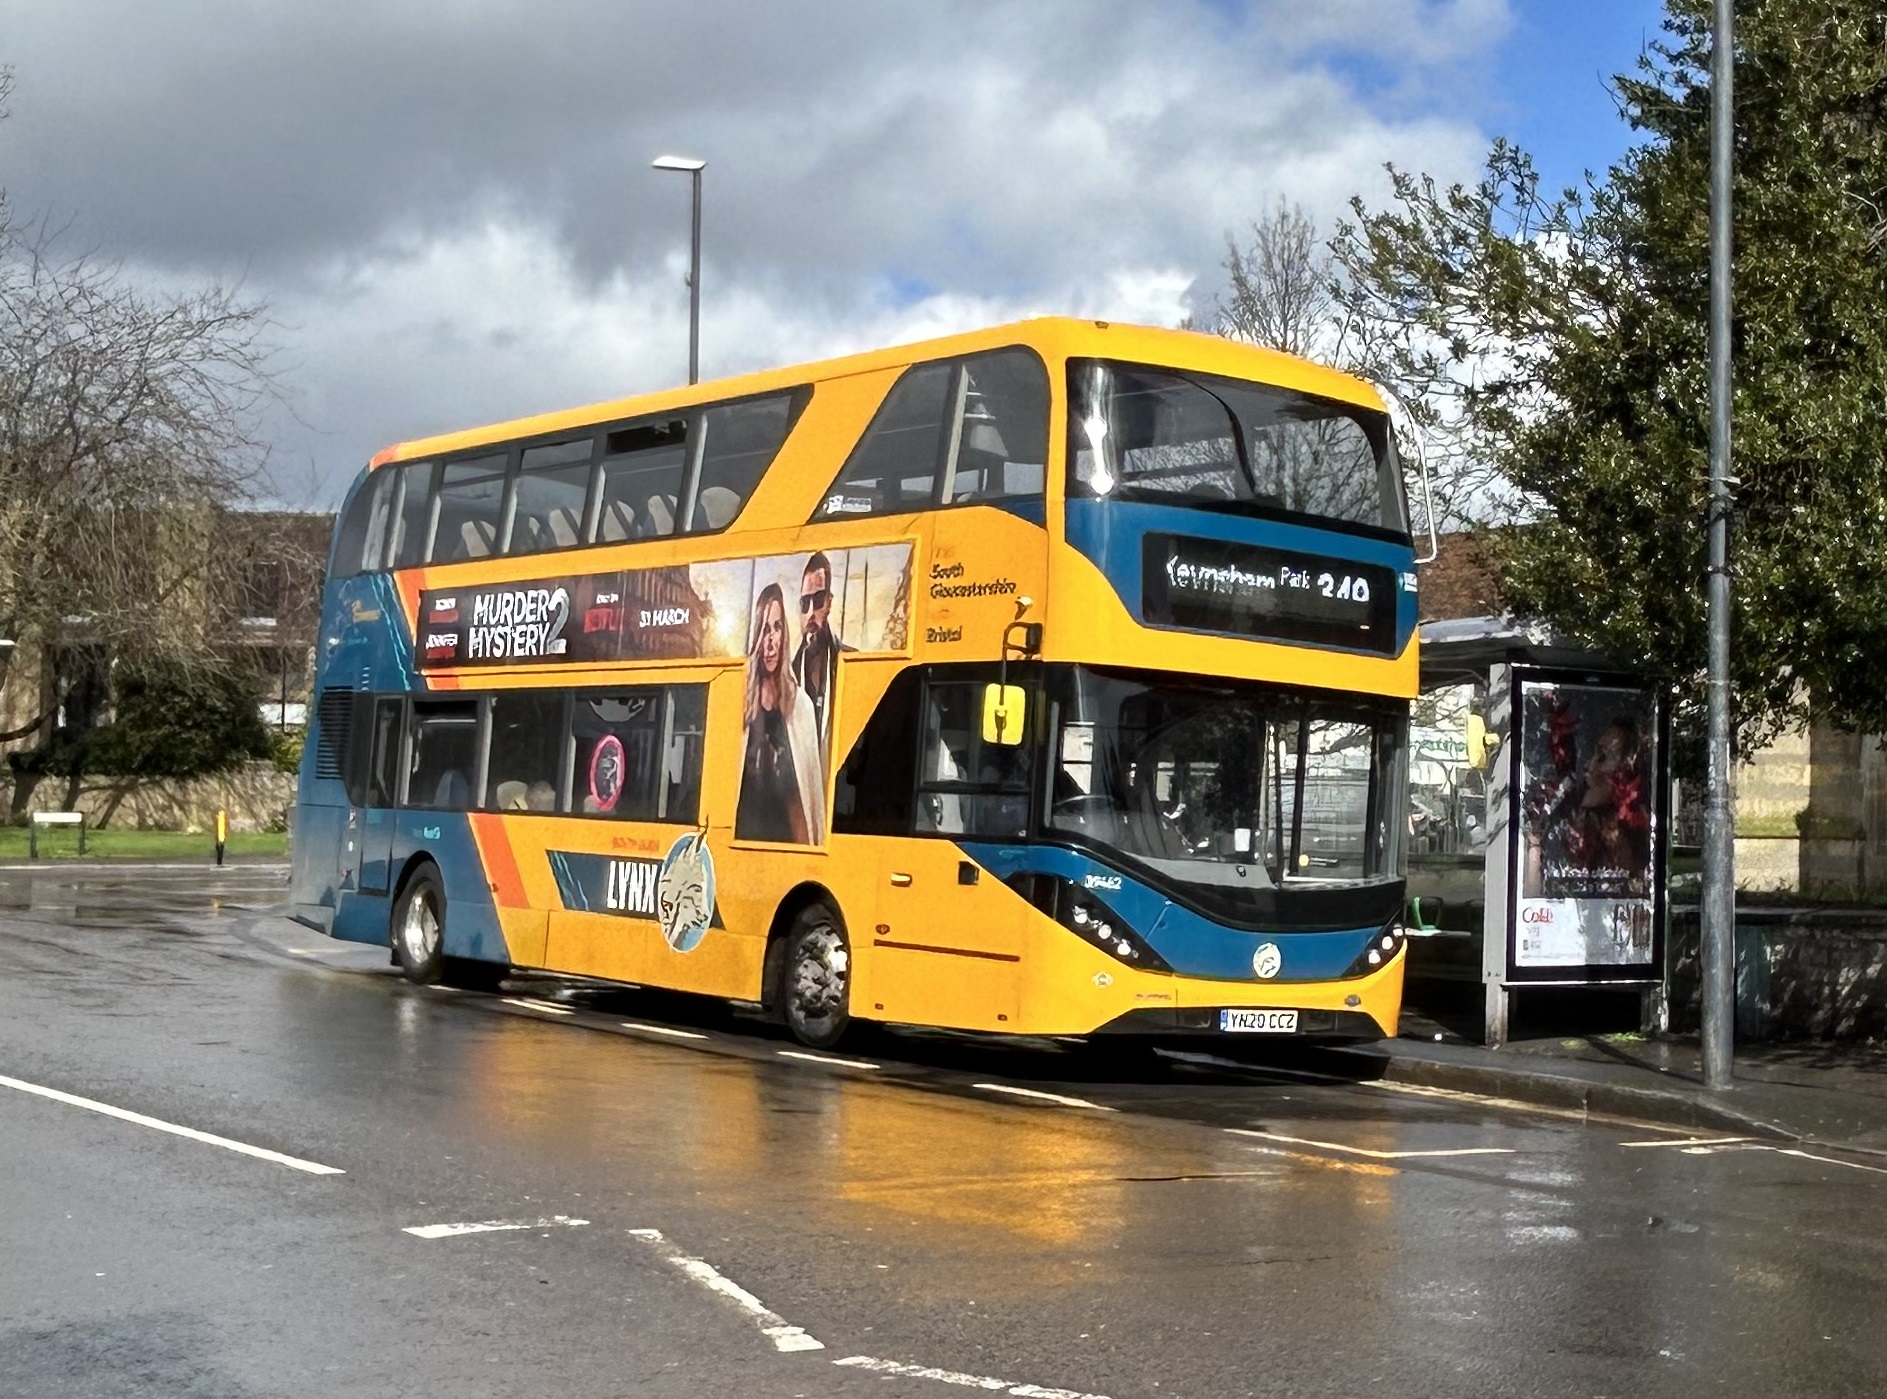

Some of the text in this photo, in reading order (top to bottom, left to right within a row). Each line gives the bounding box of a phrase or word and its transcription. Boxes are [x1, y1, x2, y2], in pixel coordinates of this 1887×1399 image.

[468, 623, 550, 659] MYSTERY
[473, 588, 549, 626] MURDER
[547, 587, 571, 655] 2
[606, 860, 658, 914] LYNX
[1269, 1013, 1295, 1029] CCZ
